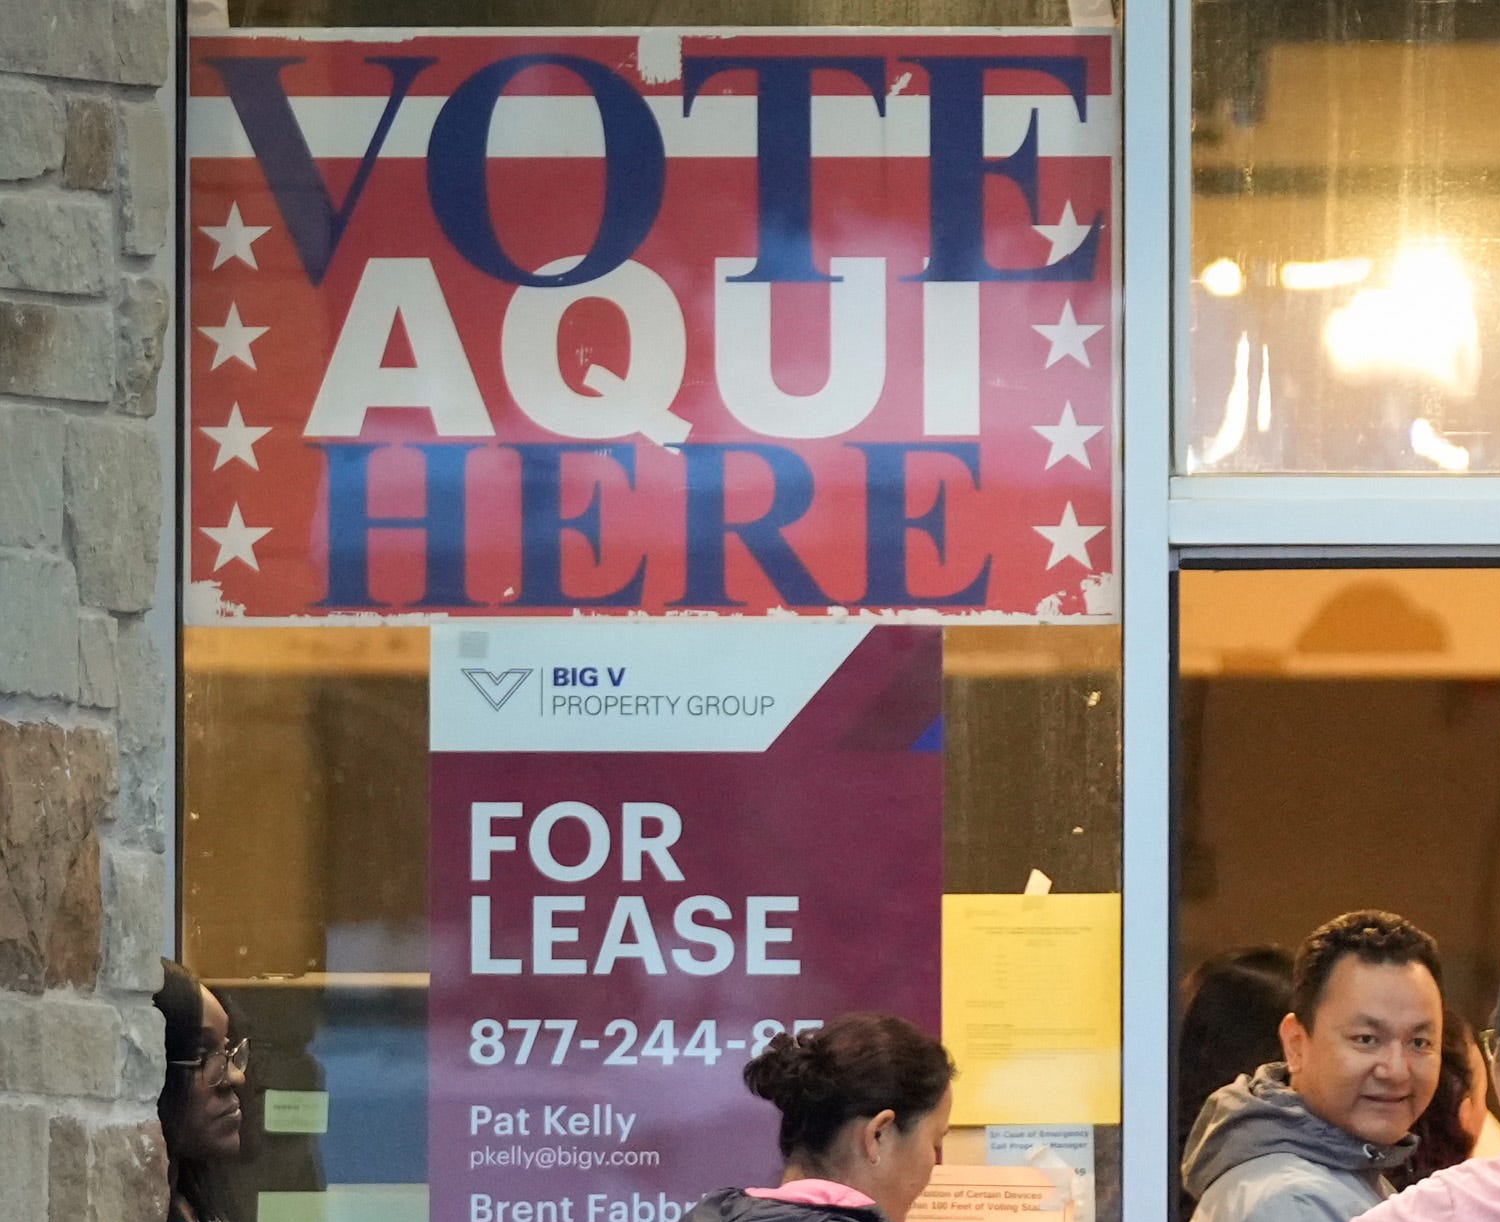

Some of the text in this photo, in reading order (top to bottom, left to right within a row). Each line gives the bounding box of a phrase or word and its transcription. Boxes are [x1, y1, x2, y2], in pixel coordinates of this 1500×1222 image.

[201, 53, 1105, 288] VOTE
[302, 255, 980, 453] AQUI
[302, 441, 992, 608] HERE
[552, 695, 775, 717] PROPERTY GROUP
[553, 667, 626, 688] BIG V
[470, 800, 685, 882] FOR
[470, 895, 801, 976] LEASE
[470, 1104, 636, 1142] Pat Kelly
[470, 1146, 660, 1169] pkelly@bigv.com
